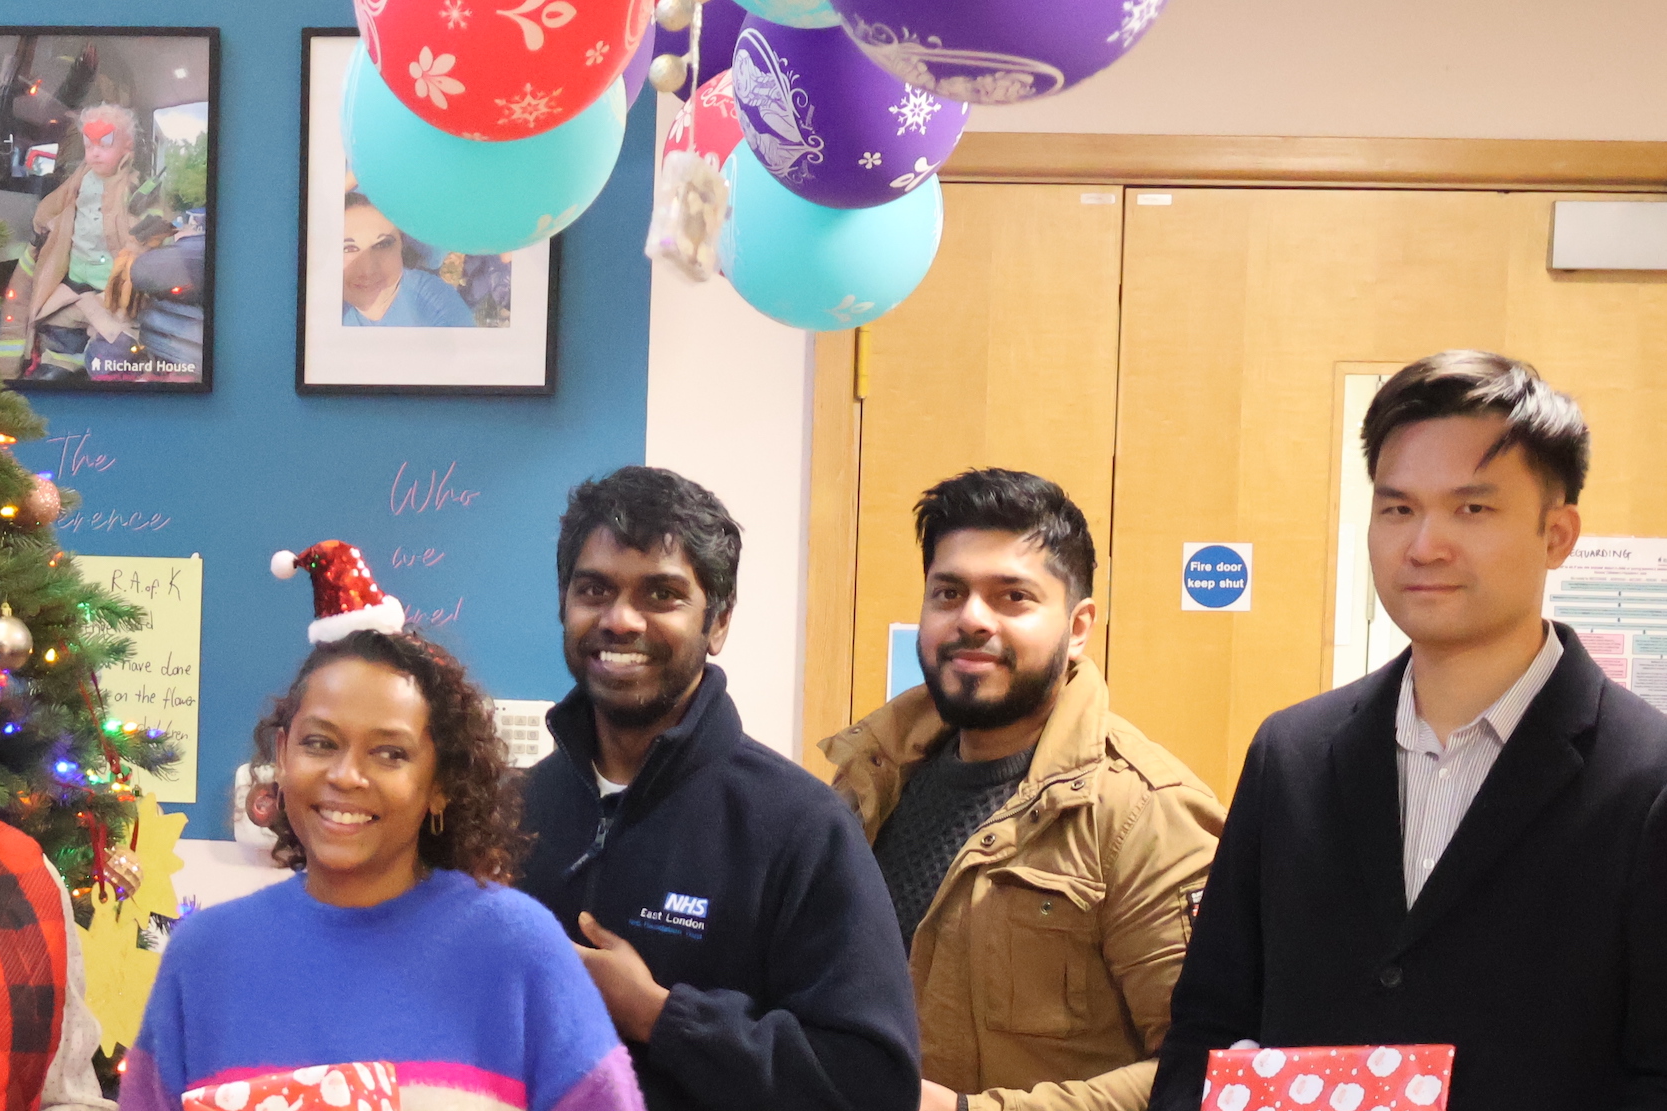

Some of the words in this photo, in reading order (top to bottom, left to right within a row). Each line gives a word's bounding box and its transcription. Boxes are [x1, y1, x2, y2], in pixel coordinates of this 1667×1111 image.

[104, 359, 152, 372] Richard
[156, 360, 196, 372] House
[46, 428, 116, 479] The
[390, 461, 481, 516] Who
[57, 508, 171, 533] erence
[1570, 549, 1632, 560] EGUARDING
[1190, 561, 1213, 572] Fire
[1216, 562, 1243, 572] door
[1187, 578, 1216, 590] keep
[1219, 578, 1245, 589] shut
[161, 651, 192, 676] done
[114, 692, 128, 703] on
[134, 684, 156, 703] the
[664, 892, 708, 917] NHS
[640, 907, 662, 920] East
[665, 914, 705, 930] London
